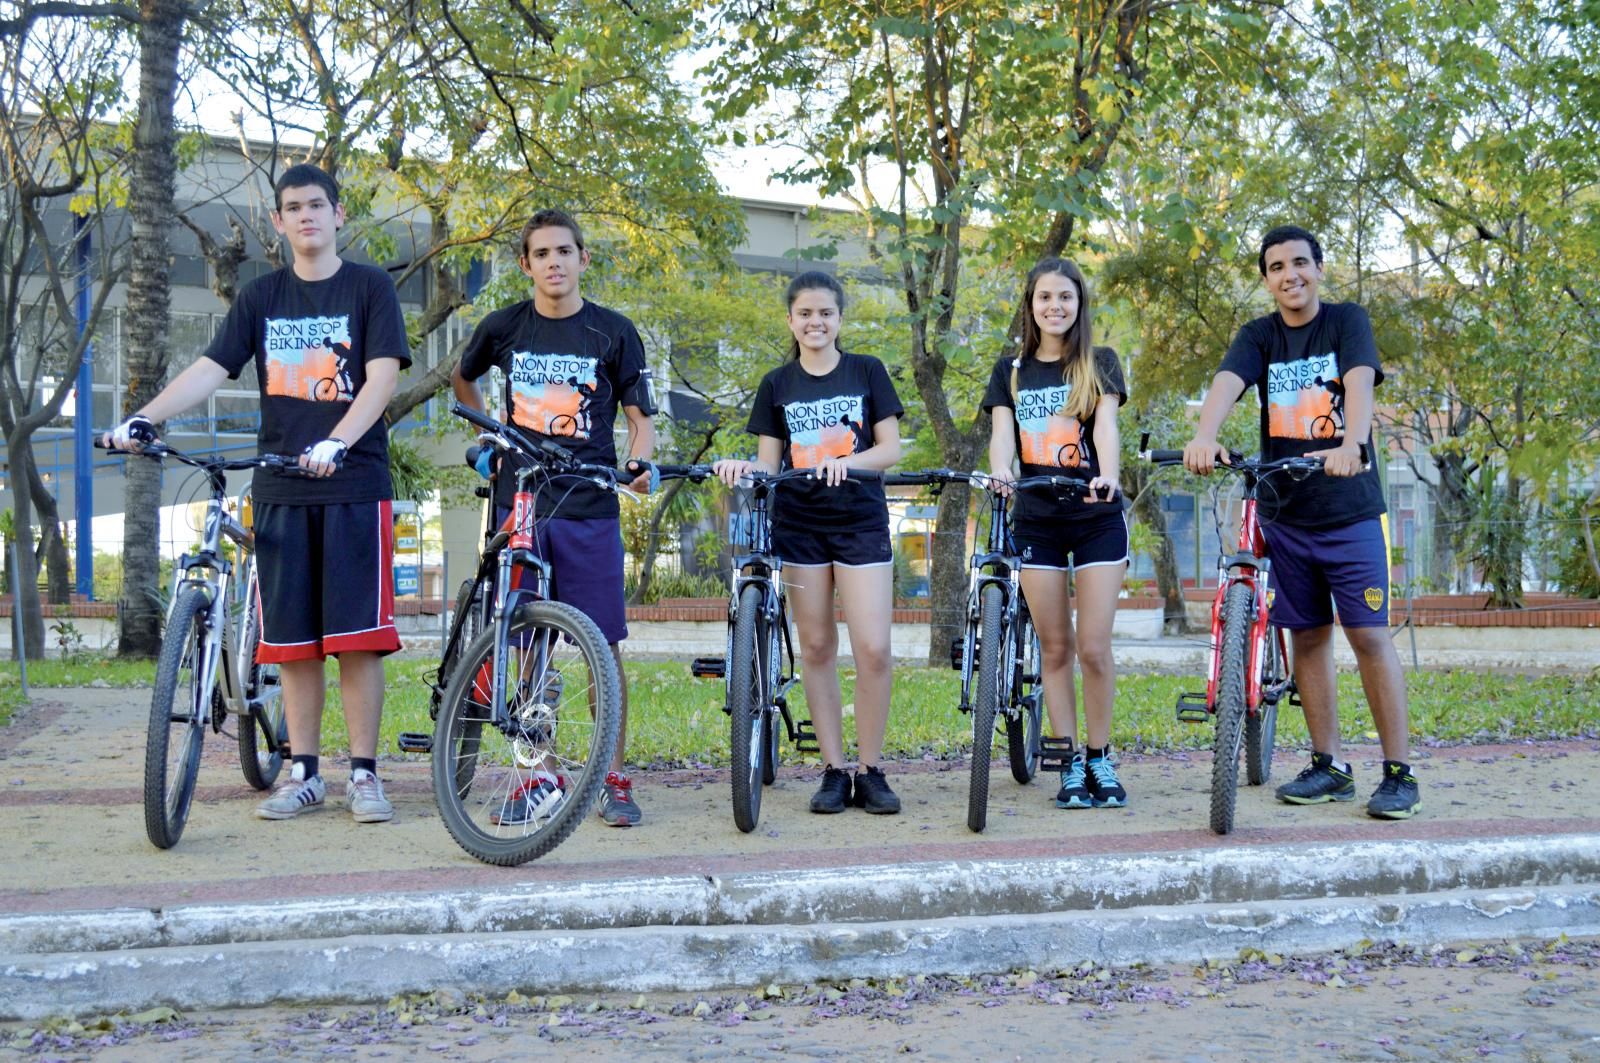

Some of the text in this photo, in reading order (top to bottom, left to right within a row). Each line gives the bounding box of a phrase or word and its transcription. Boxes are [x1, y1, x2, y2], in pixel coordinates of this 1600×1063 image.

[270, 321, 342, 337] NON STOP
[270, 337, 321, 350] BIKING
[515, 357, 590, 374] NON STOP
[1269, 359, 1330, 381] NON STOP
[513, 371, 565, 385] BIKING
[1268, 378, 1313, 394] BIKING
[1050, 390, 1067, 404] ST
[786, 399, 858, 421] NON STOP
[789, 415, 838, 433] BIKING
